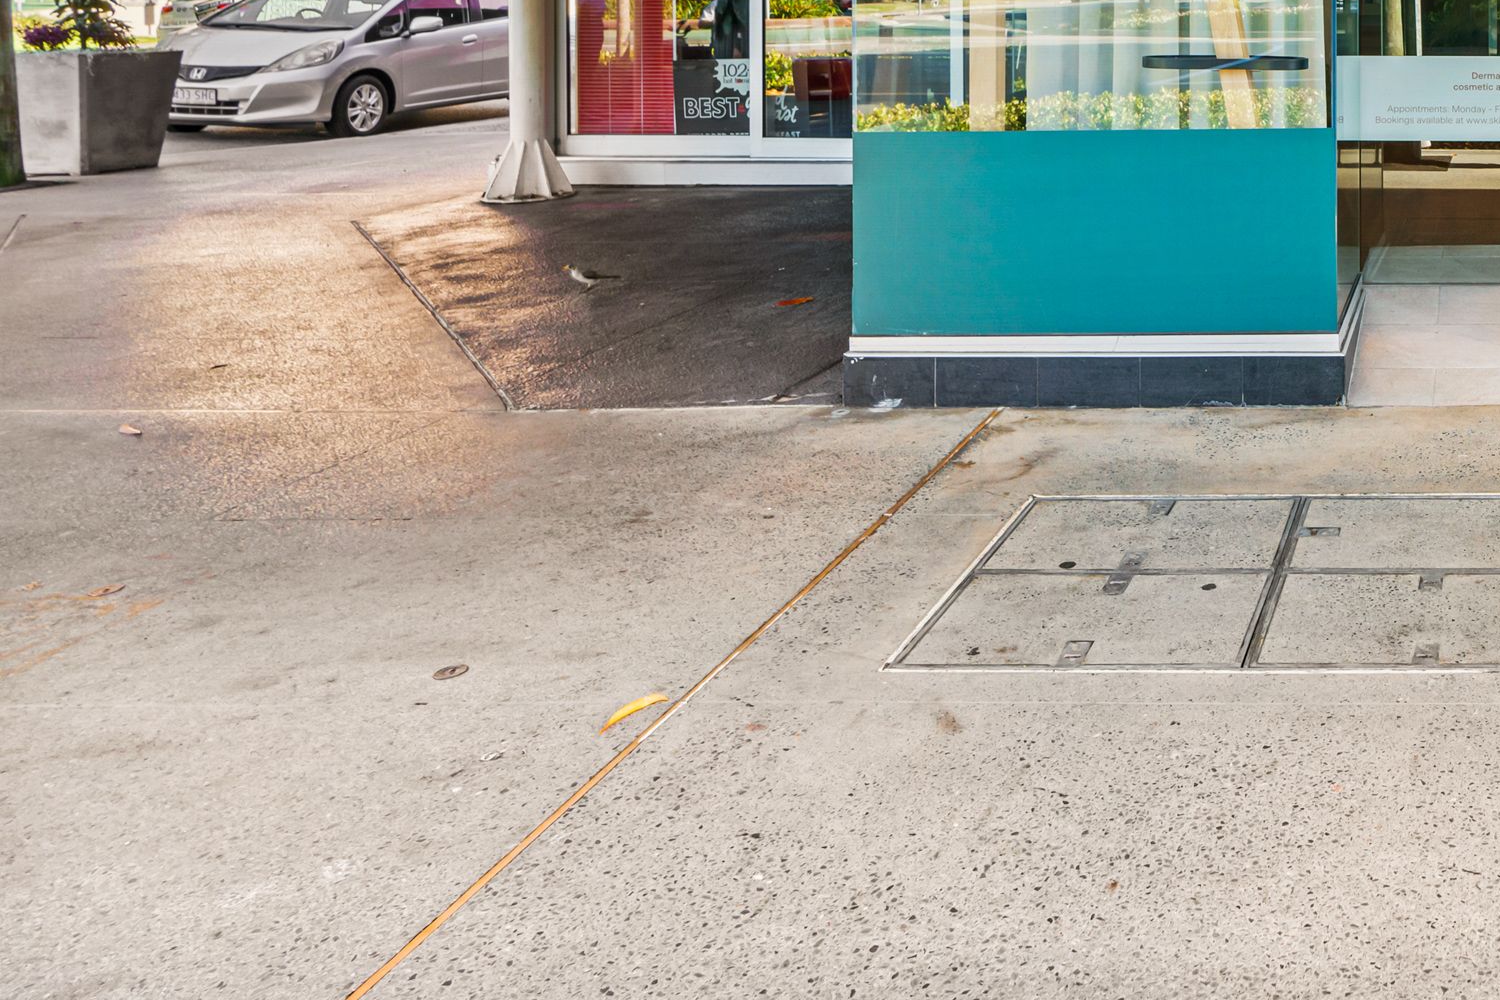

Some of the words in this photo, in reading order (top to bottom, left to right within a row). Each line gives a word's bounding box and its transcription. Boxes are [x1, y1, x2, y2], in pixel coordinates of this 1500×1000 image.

[1453, 83, 1494, 91] cosmetic
[683, 97, 740, 119] BEST
[1451, 105, 1486, 115] Monday
[1375, 116, 1415, 126] Bookings
[1416, 116, 1453, 125] available
[1455, 117, 1464, 125] at
